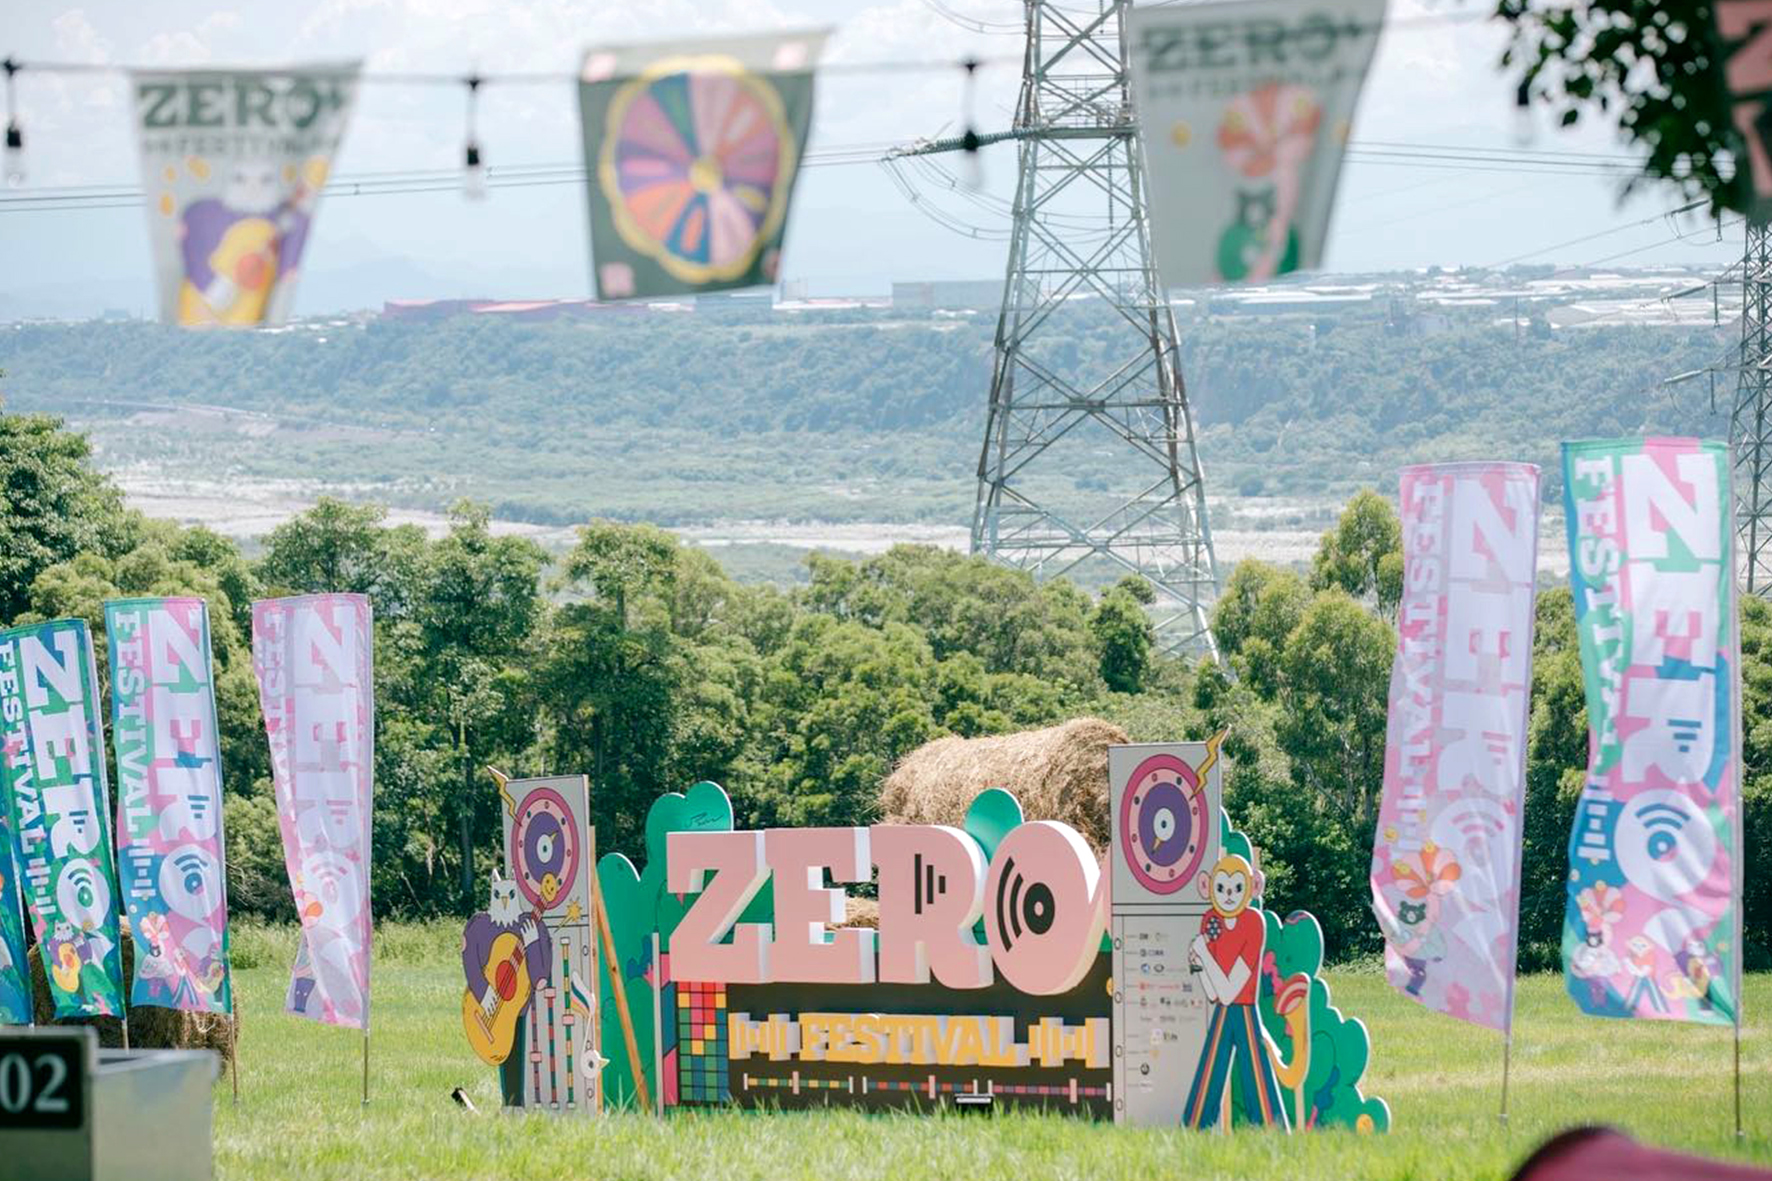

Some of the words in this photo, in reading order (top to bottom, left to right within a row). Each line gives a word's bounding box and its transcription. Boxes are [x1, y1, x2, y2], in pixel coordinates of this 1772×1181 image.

[0, 640, 49, 854] FESTIVAL
[114, 611, 151, 832] FESTIVAL
[147, 608, 226, 924] ZERO
[294, 606, 361, 928] ZERO
[1397, 481, 1444, 778] FESTIVAL
[1432, 476, 1534, 902] ZERO
[1614, 452, 1720, 901] ZERO
[19, 630, 110, 930] ZERO
[667, 820, 1100, 995] ZERO
[0, 1053, 69, 1113] 02
[800, 1013, 1027, 1067] FESTIVAL
